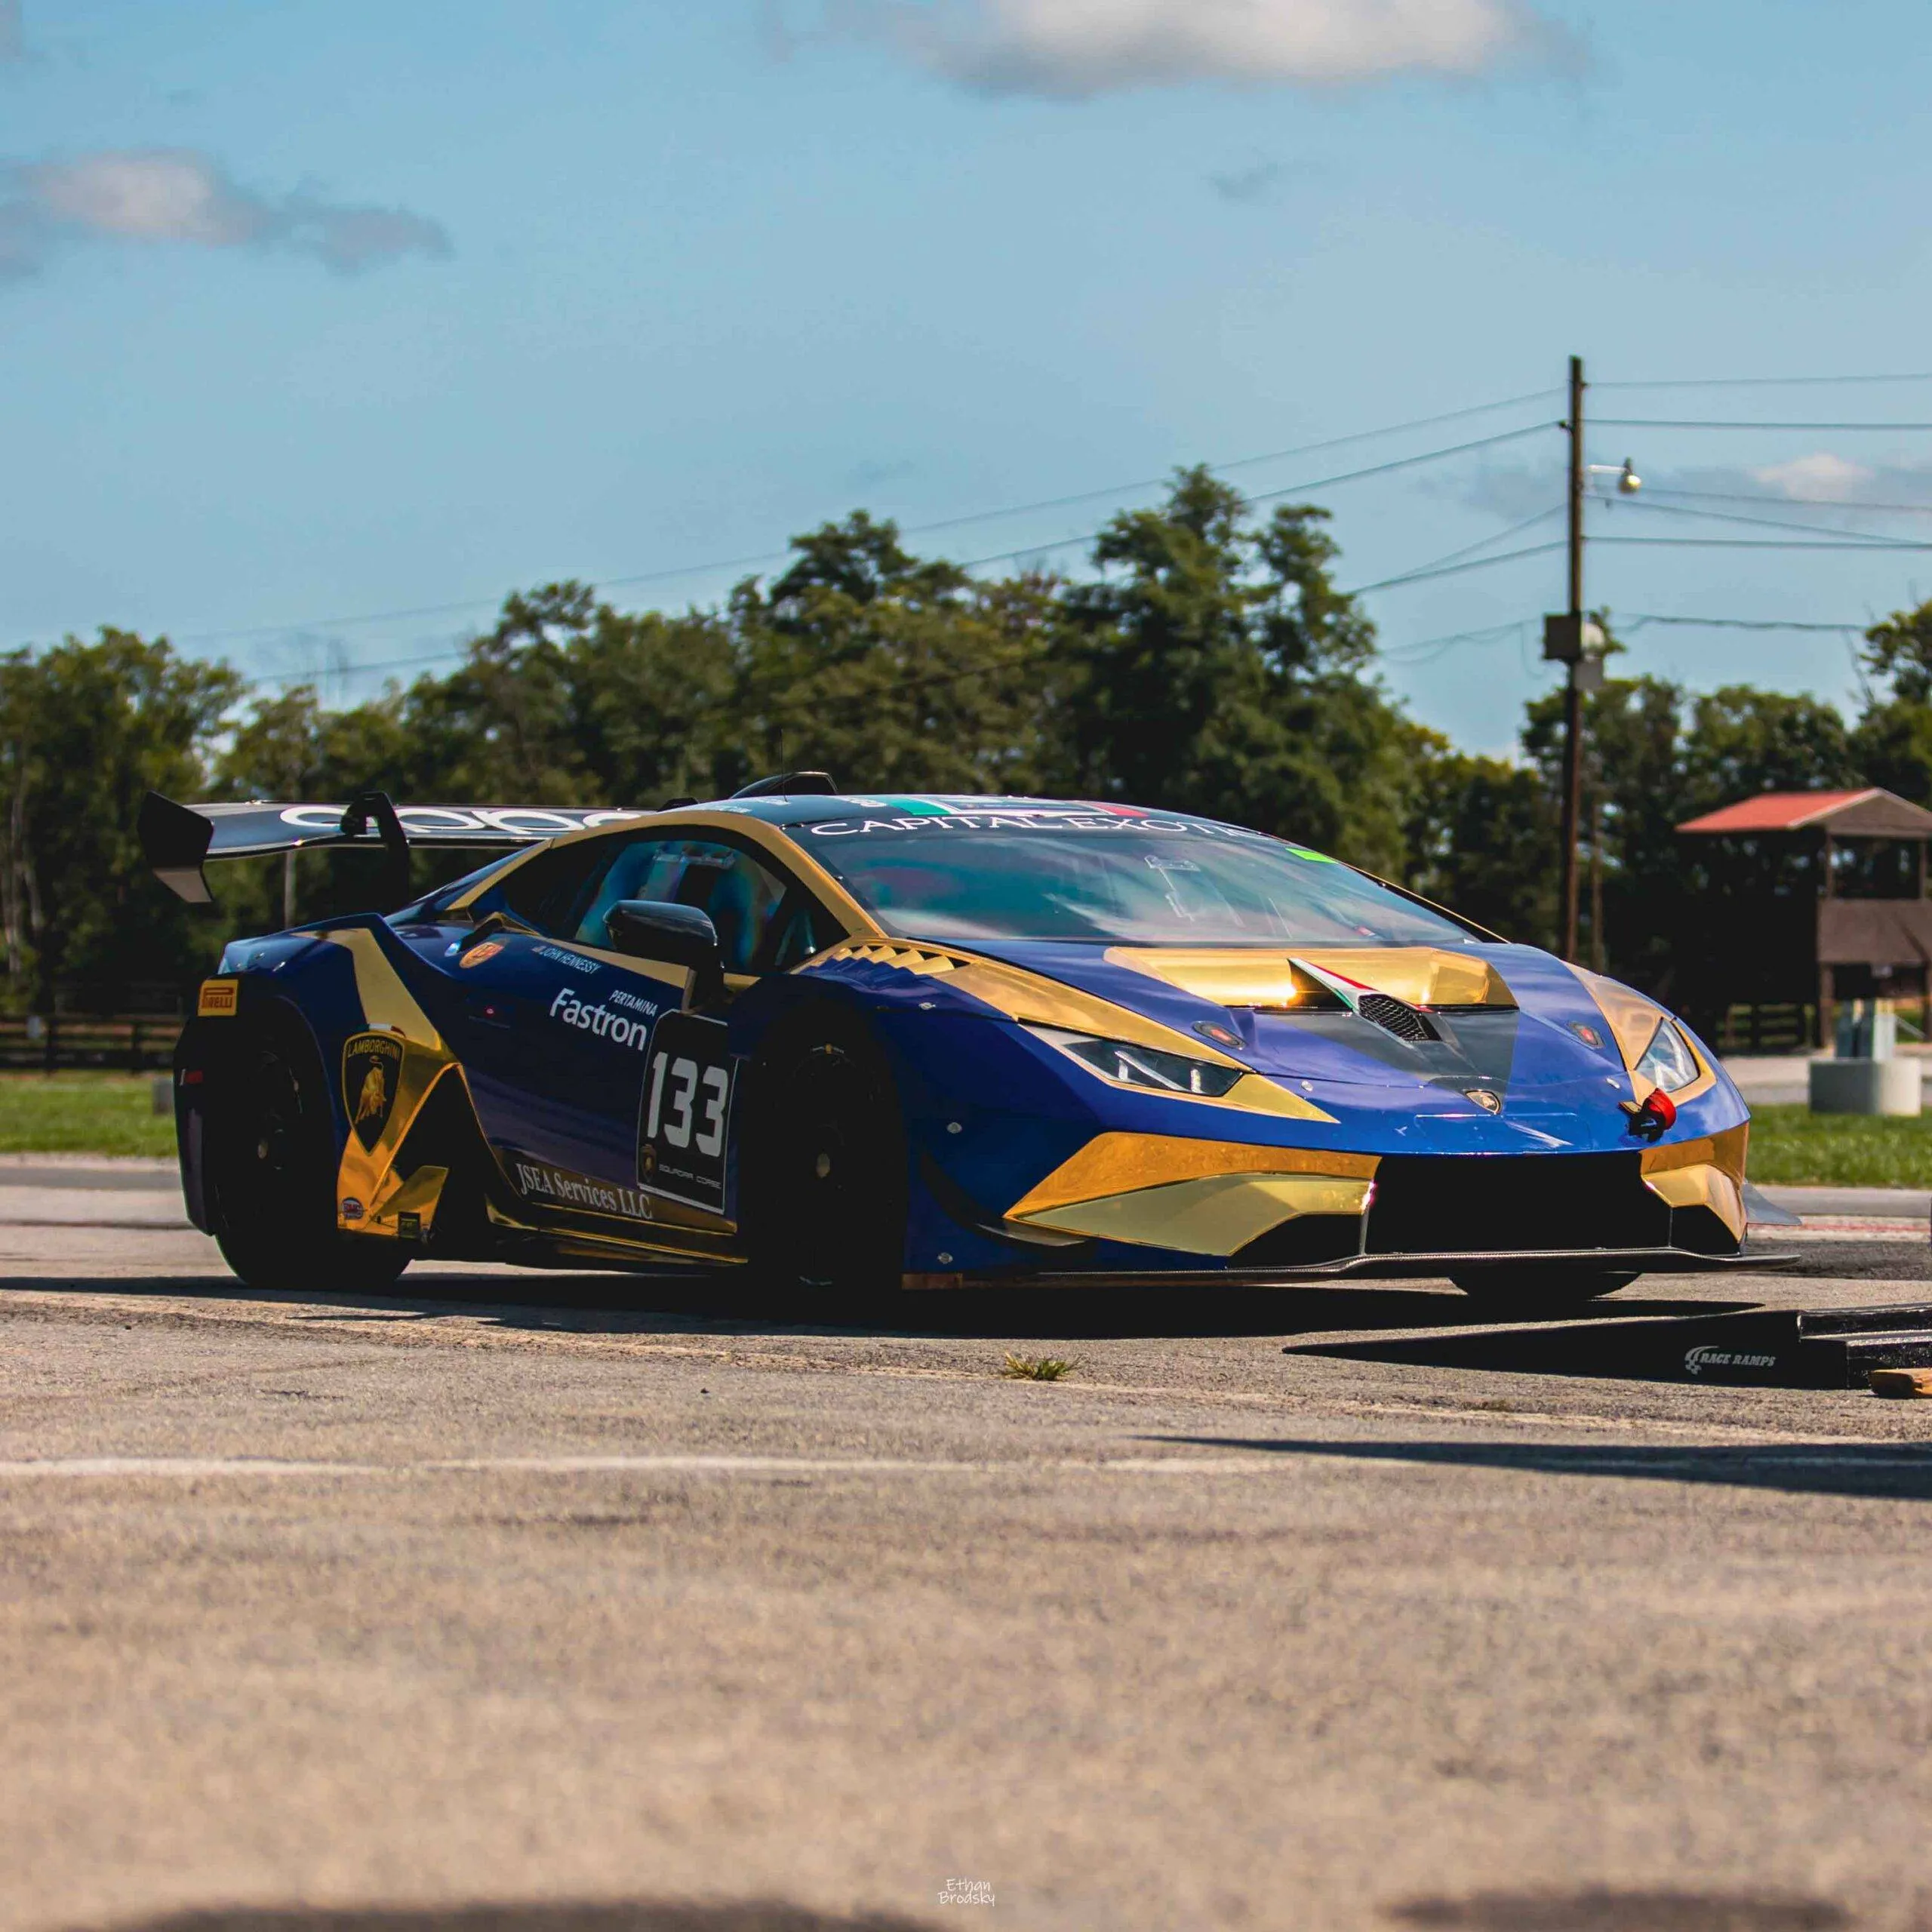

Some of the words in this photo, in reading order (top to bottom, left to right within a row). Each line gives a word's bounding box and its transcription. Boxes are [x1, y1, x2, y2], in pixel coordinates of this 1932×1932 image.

[811, 816, 1063, 835] CAPITAL
[549, 988, 648, 1051] Fastron
[609, 989, 659, 1017] PERTAMINA
[648, 1051, 728, 1157] 133
[515, 1163, 555, 1195] JSEA
[554, 1172, 617, 1211] Services
[617, 1188, 654, 1220] LLC
[1699, 1352, 1732, 1364] RACE
